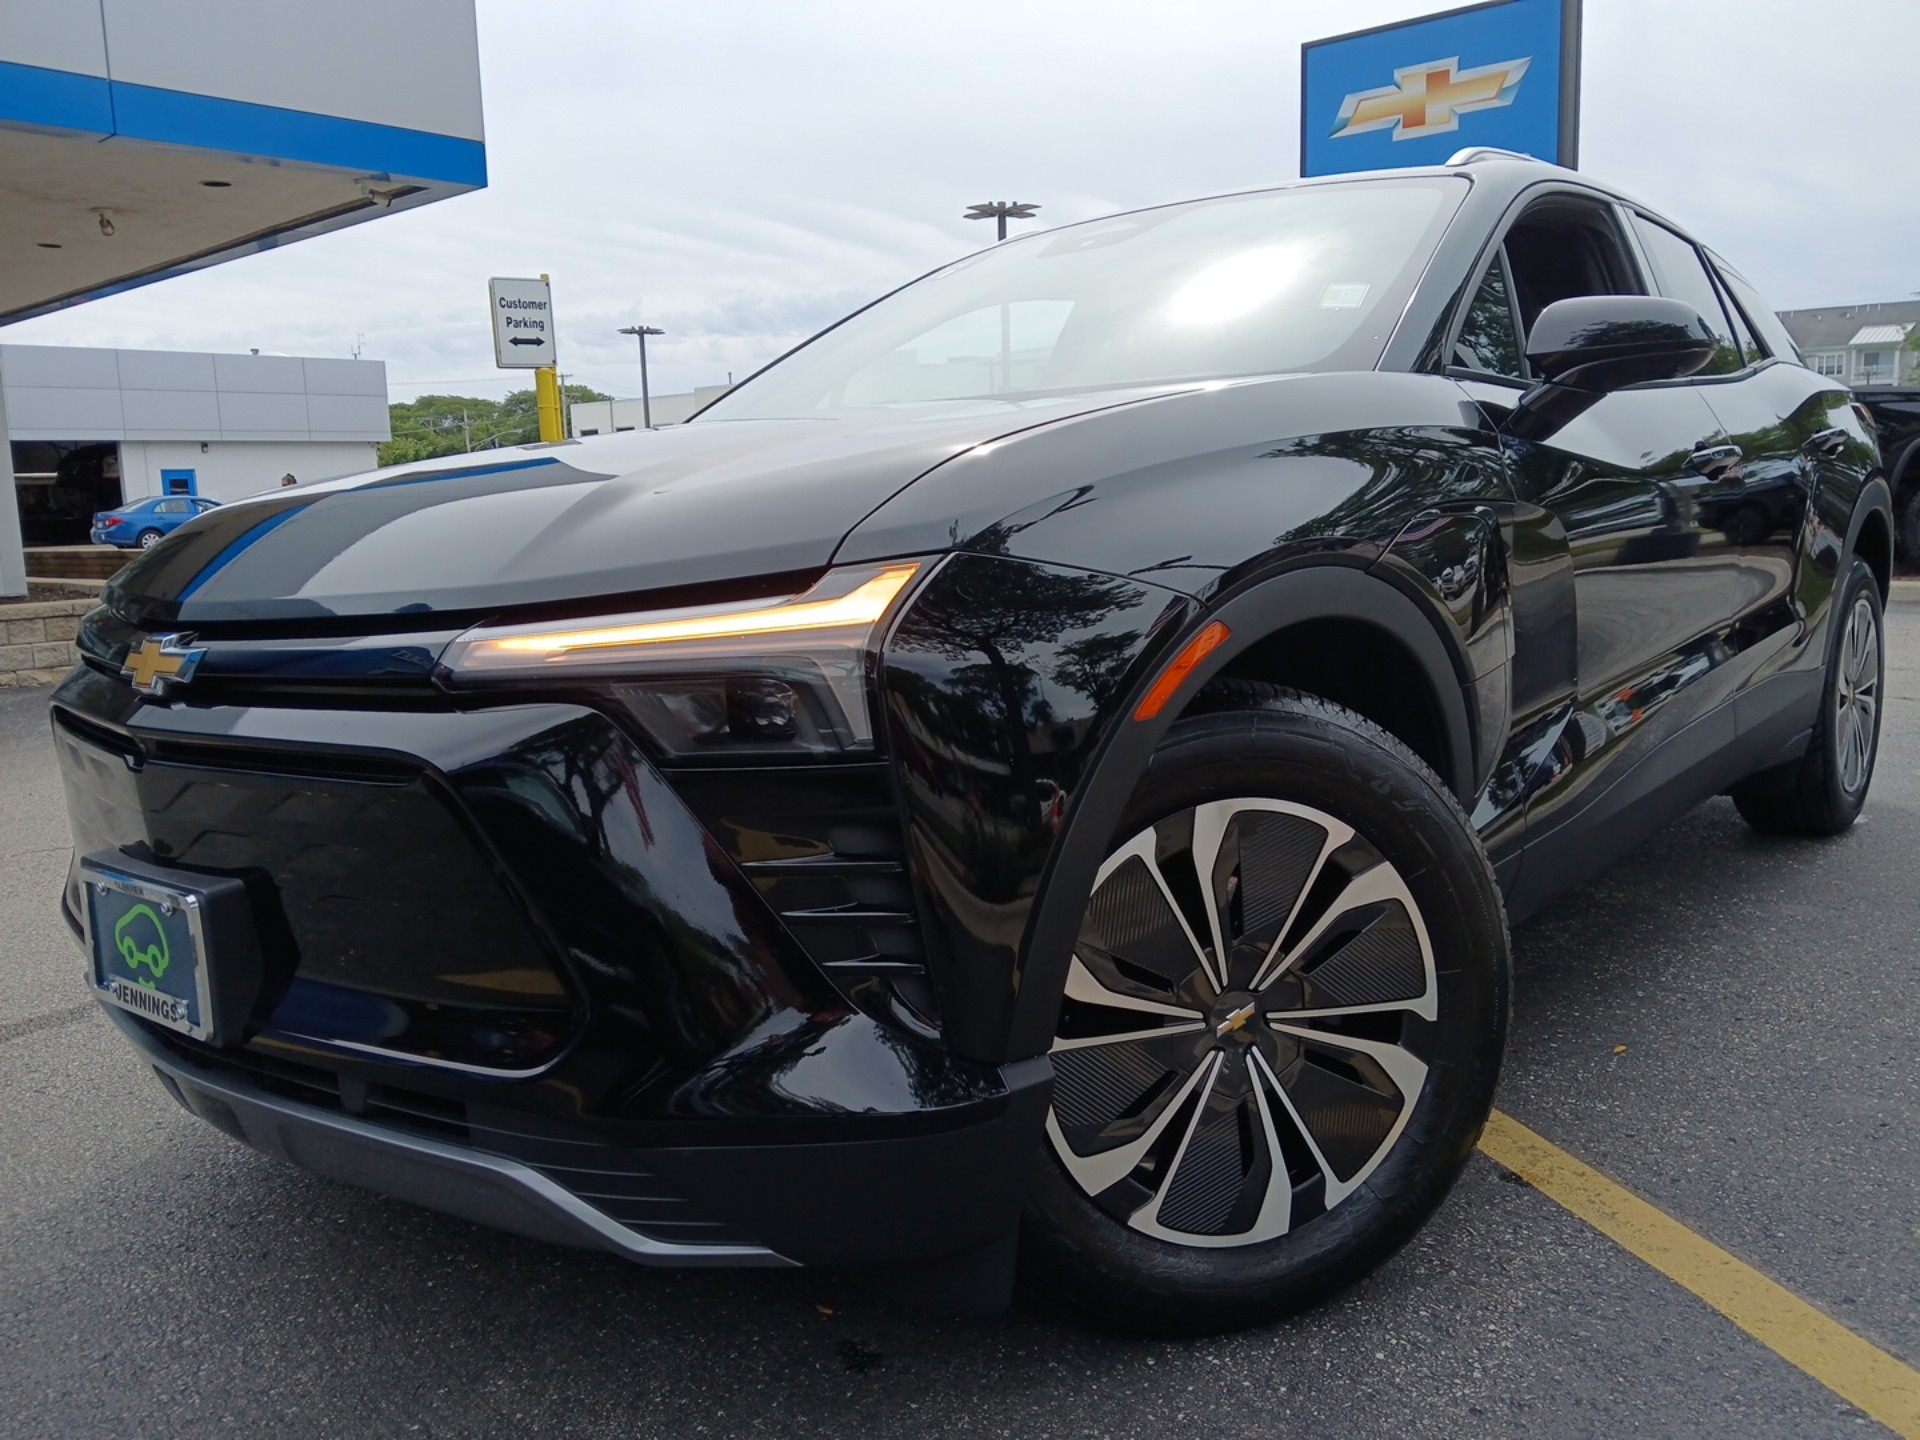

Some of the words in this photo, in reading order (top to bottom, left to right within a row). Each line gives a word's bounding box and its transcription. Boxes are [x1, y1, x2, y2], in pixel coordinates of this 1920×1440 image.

[499, 297, 547, 310] Customer
[506, 317, 545, 332] Parking
[115, 983, 179, 1023] JENNINGS
